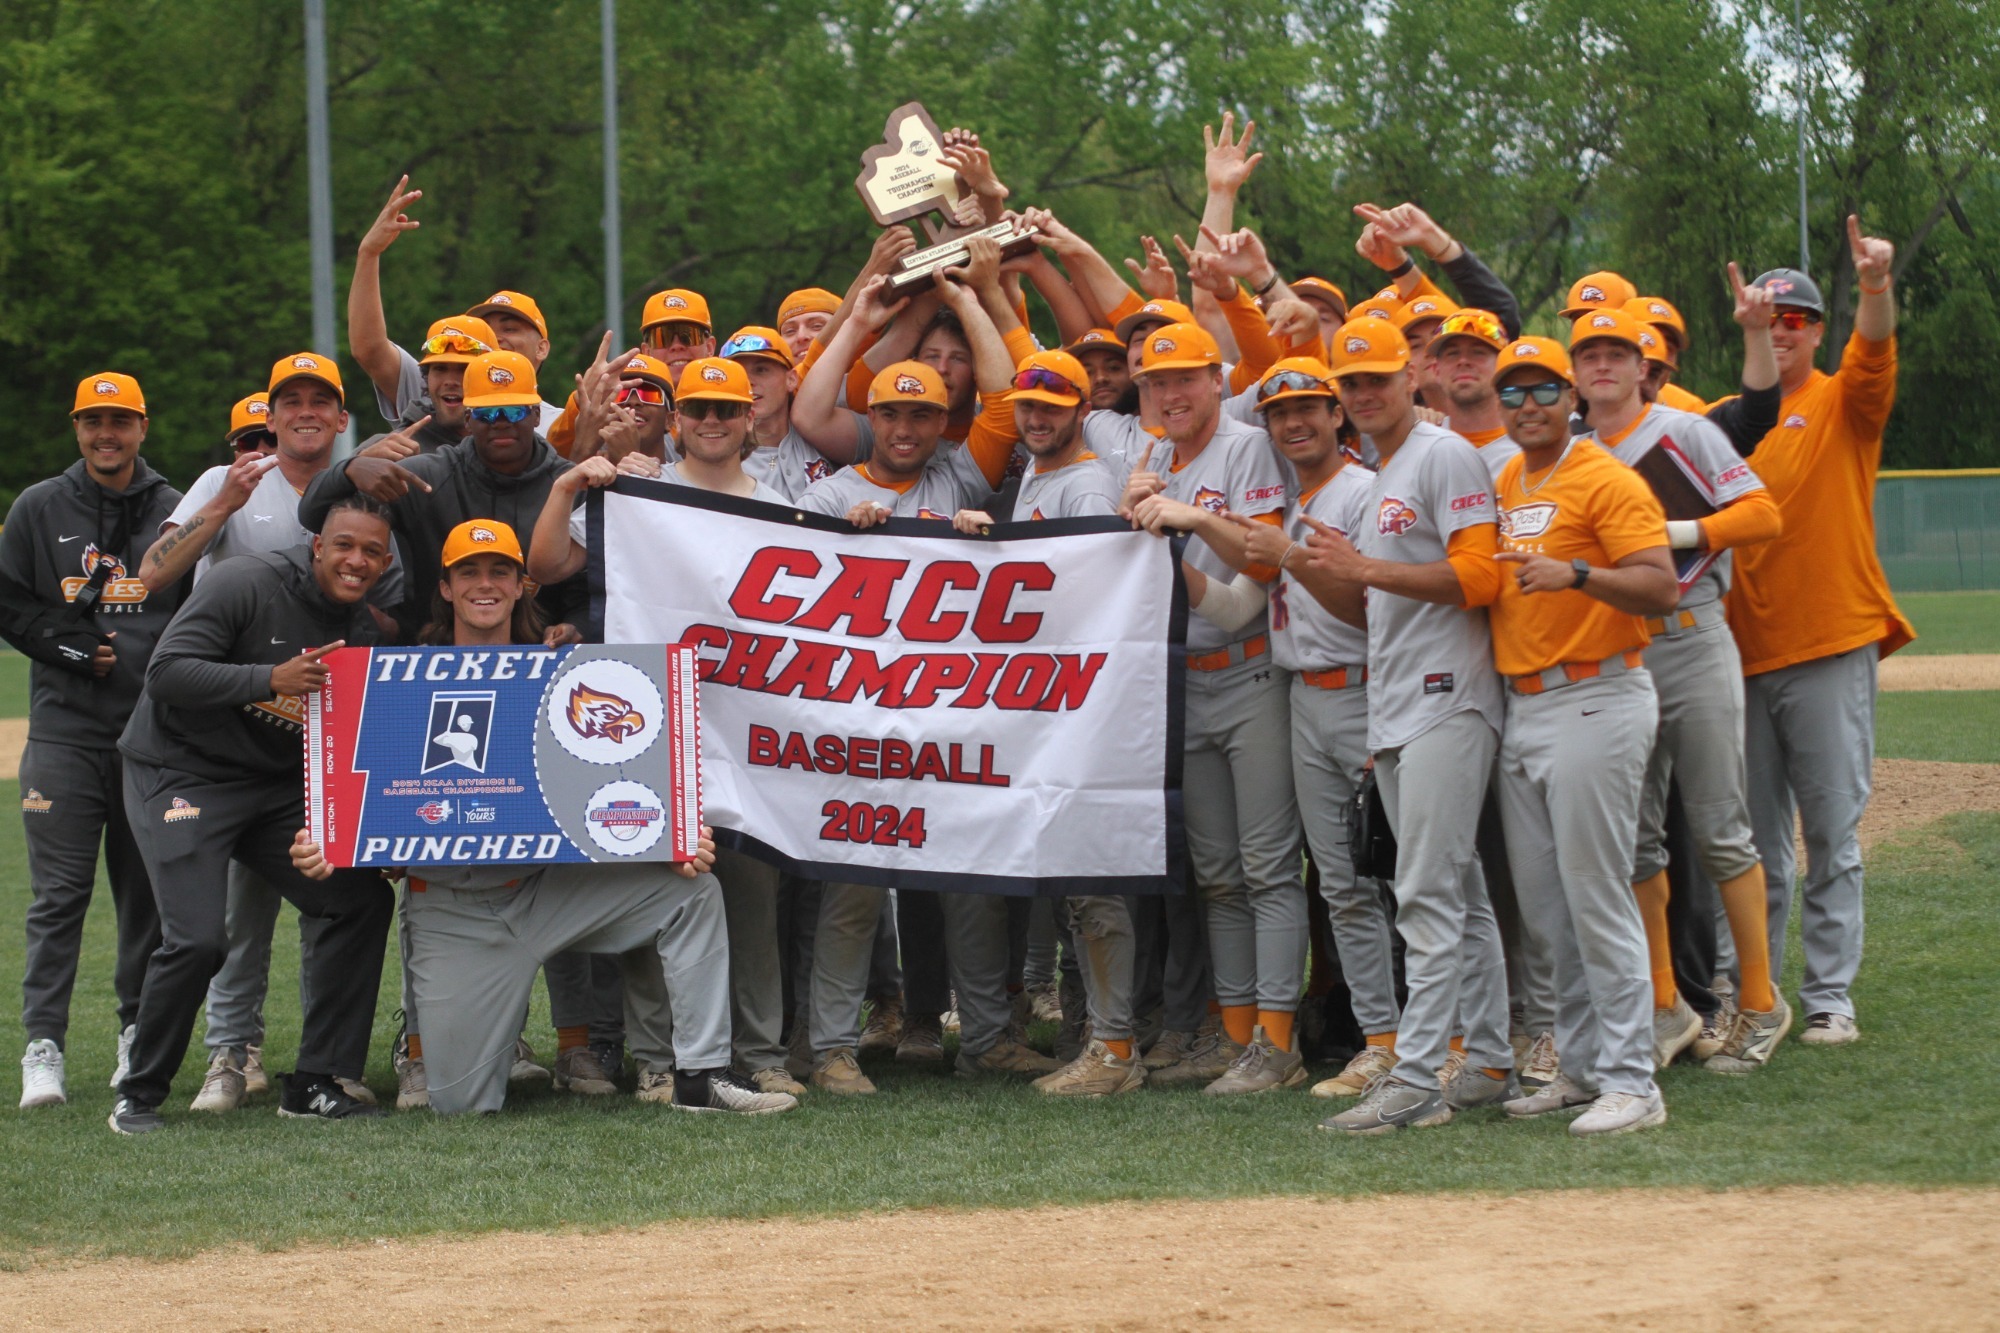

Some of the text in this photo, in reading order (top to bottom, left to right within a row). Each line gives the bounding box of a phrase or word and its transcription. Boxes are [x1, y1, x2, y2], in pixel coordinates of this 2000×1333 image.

[889, 167, 922, 181] BASEBALL
[894, 163, 910, 173] 2024
[886, 173, 936, 194] TOURNAMENT
[897, 182, 934, 199] CHAMPION
[906, 253, 929, 266] CENTRAL
[929, 243, 953, 258] ATLANTIC
[1245, 484, 1285, 501] CACC
[1450, 491, 1488, 511] CACC
[1516, 510, 1543, 525] Post
[65, 583, 145, 597] ELES
[728, 545, 1056, 643] CACC
[375, 651, 557, 682] TICKET
[678, 623, 1108, 712] CHAMPION
[325, 672, 332, 685] 24
[325, 687, 333, 712] SEAT:
[673, 693, 681, 736] AUTOMATIC
[326, 736, 334, 748] 20
[326, 749, 334, 774] ROW:
[674, 736, 682, 788] TOURNAMENT
[748, 723, 1010, 788] BASEBALL
[383, 786, 525, 795] BASEBALL CHAMPIONSHIP
[392, 779, 420, 787] 2024
[423, 779, 454, 787] NCAA
[457, 778, 505, 787] DIVISION
[416, 806, 443, 816] CACC
[465, 809, 496, 823] YOURS
[591, 810, 659, 820] CHAMPIONSHIPS
[327, 802, 335, 843] SECTION:
[819, 799, 927, 848] 2024
[360, 833, 562, 862] PUNCHED
